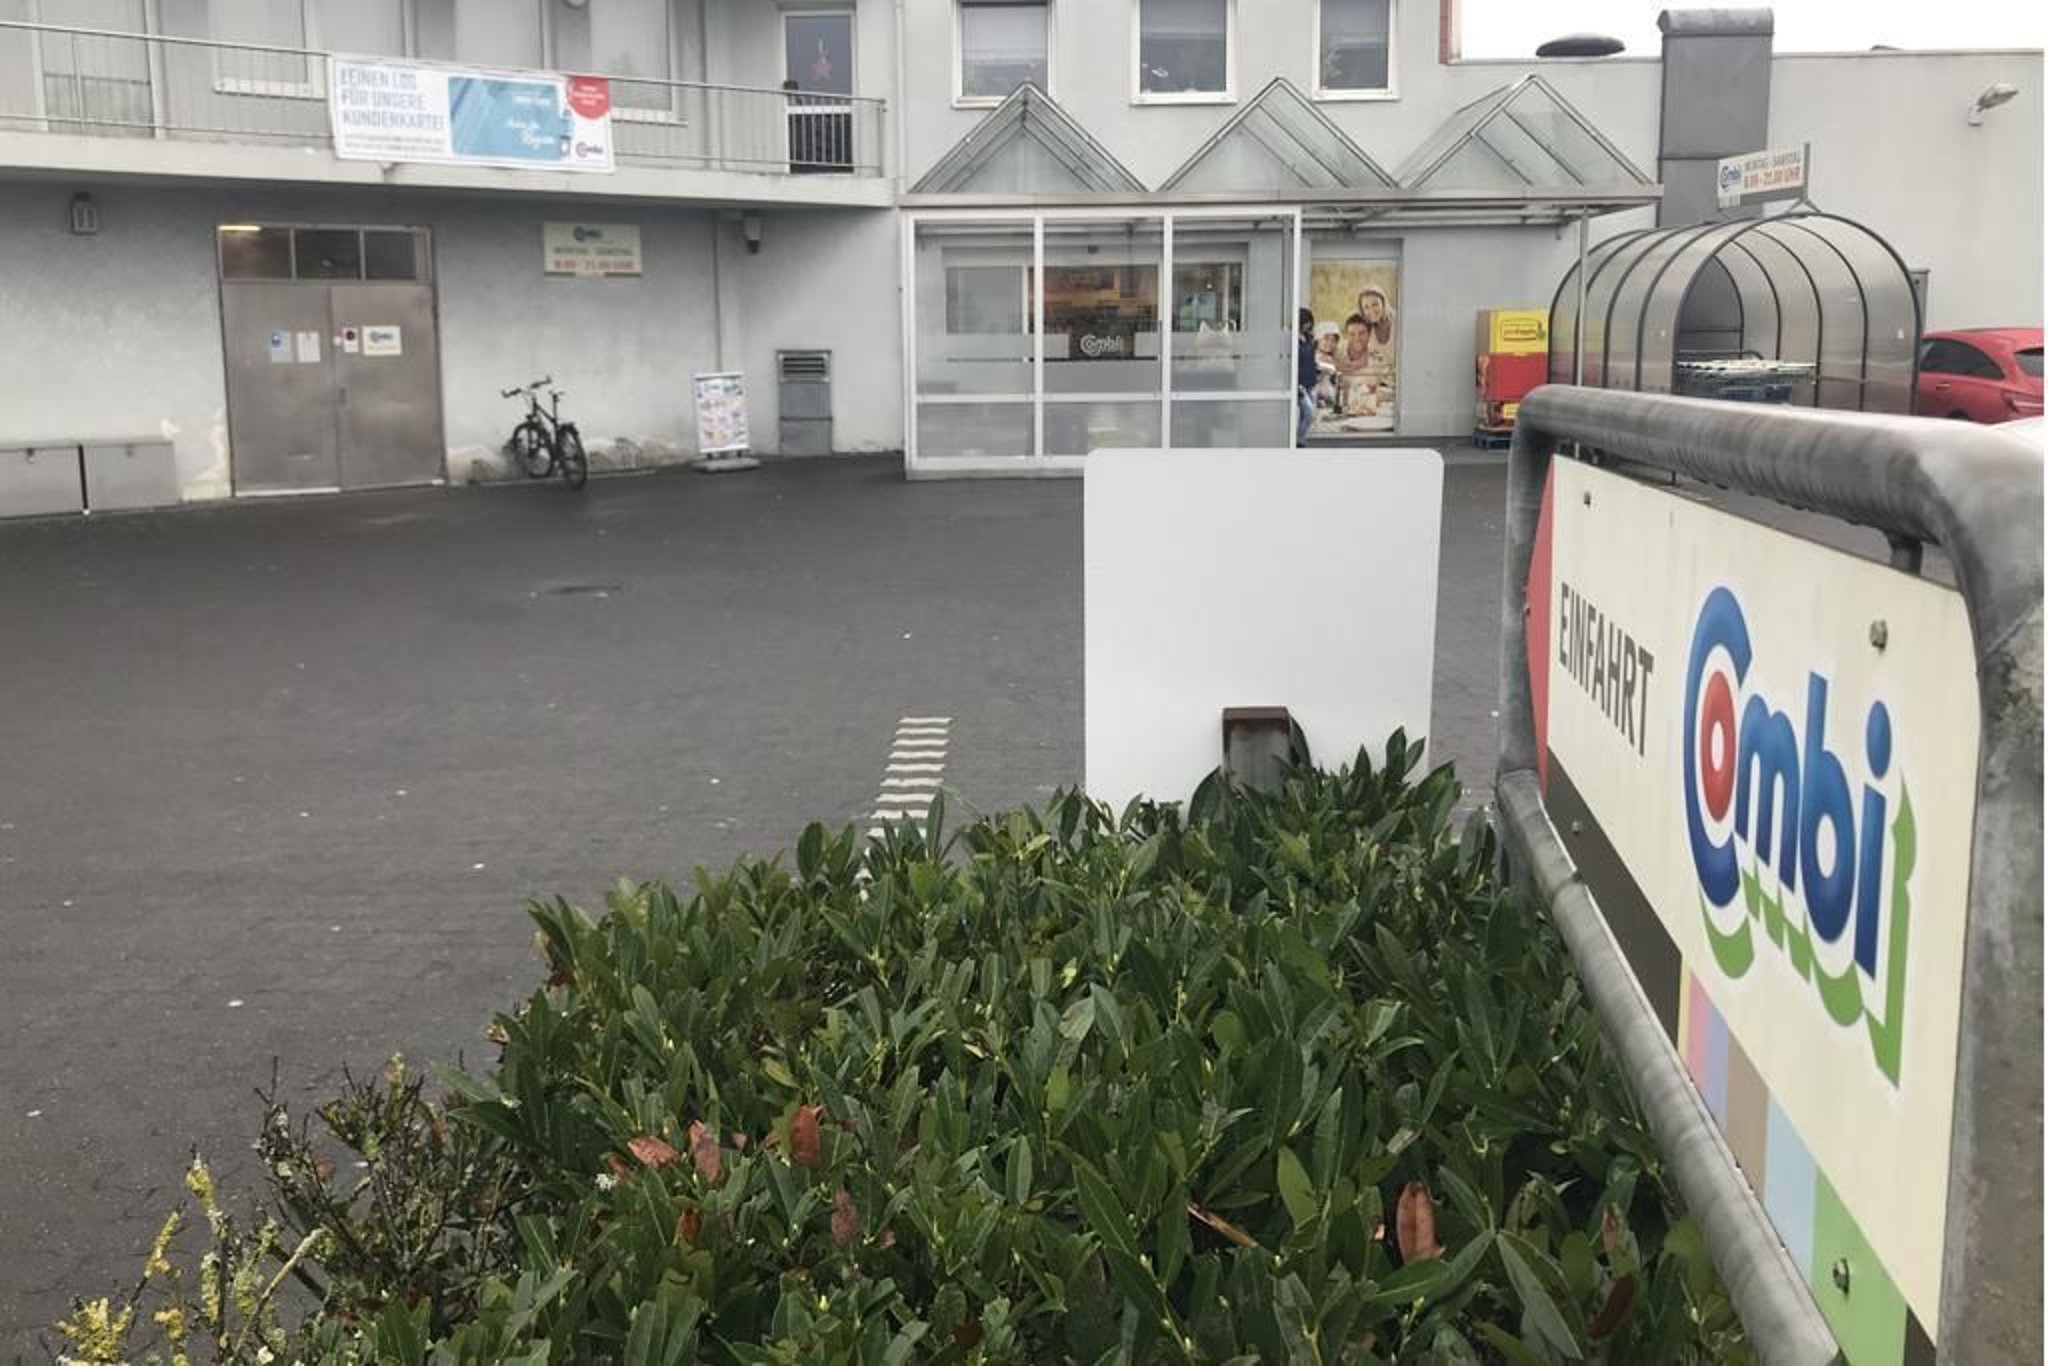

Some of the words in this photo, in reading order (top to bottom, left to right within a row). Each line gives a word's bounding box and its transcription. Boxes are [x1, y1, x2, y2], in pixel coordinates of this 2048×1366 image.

[1080, 334, 1123, 356] Combi
[1559, 581, 1654, 758] EINFAHRT
[1683, 585, 1892, 983] Combi
